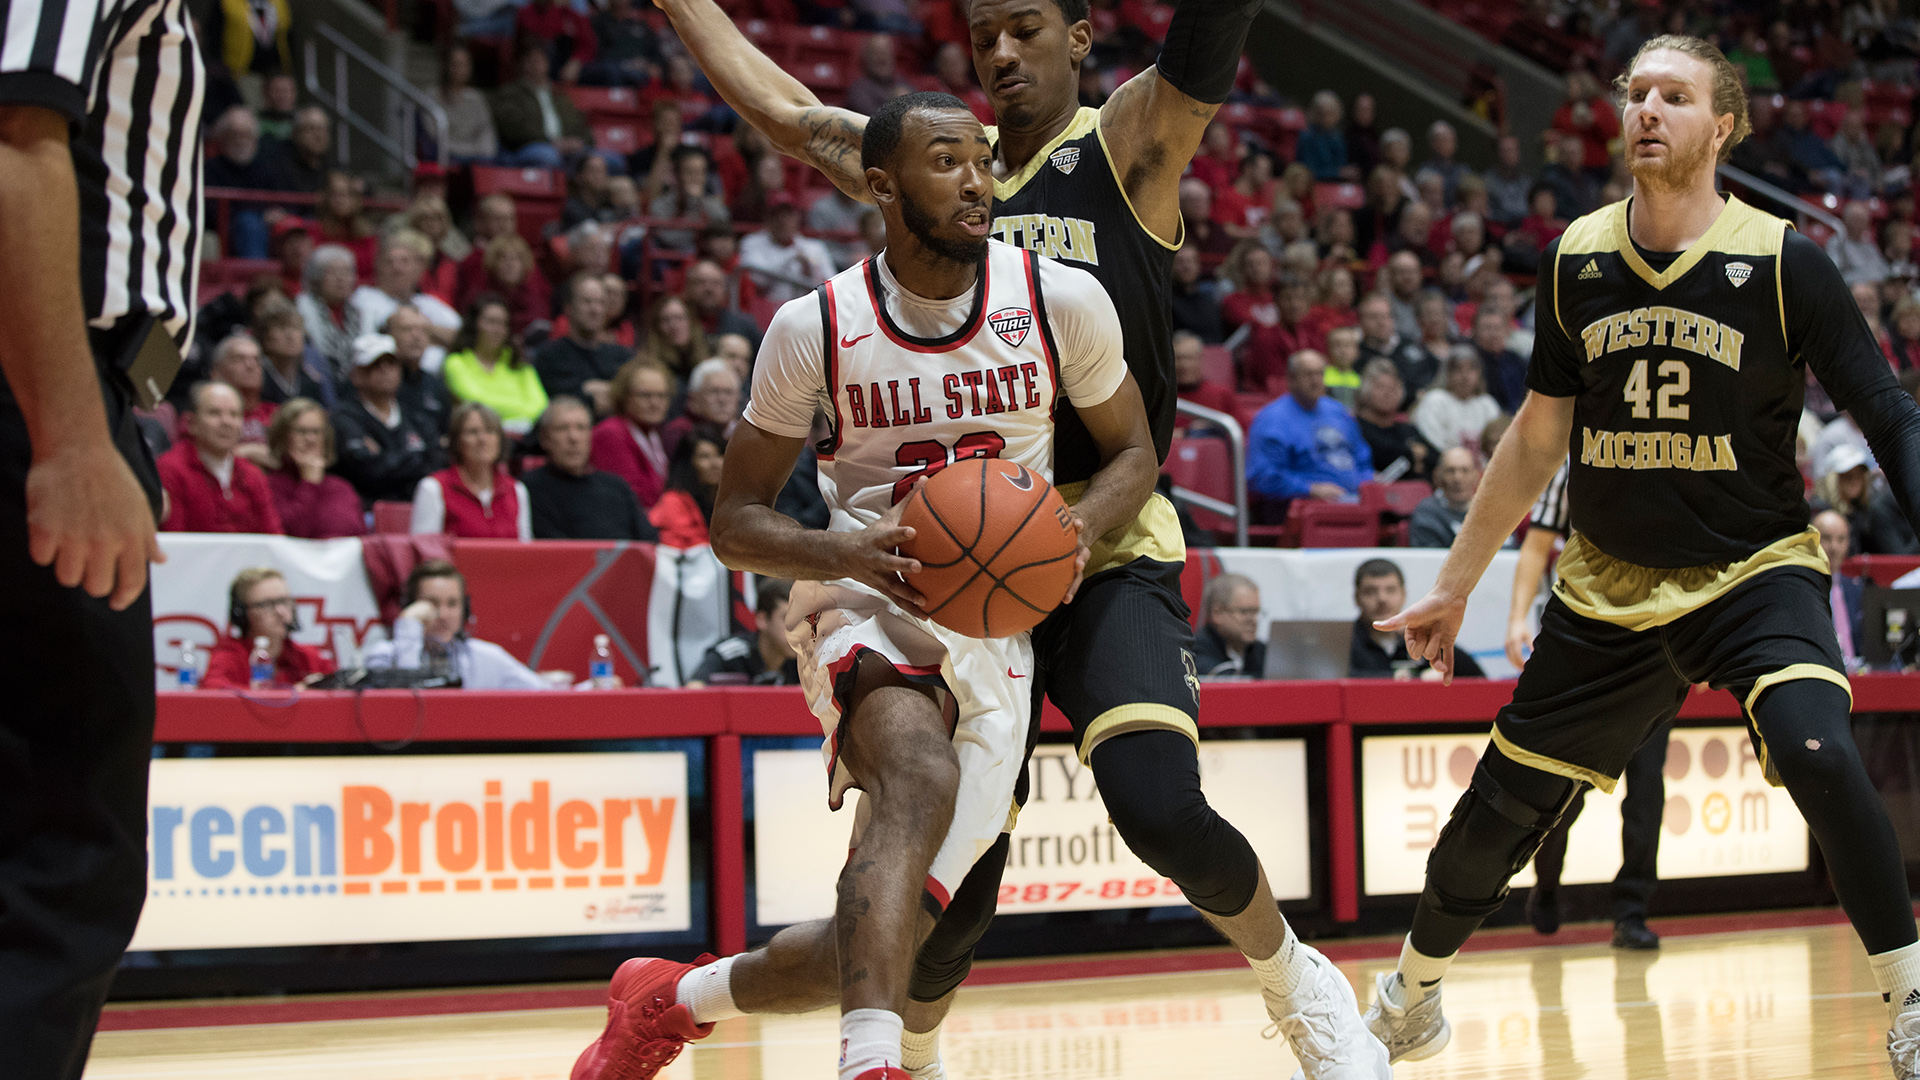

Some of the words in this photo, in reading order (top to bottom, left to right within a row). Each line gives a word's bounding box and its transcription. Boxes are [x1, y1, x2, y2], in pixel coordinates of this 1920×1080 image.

[1051, 153, 1080, 167] MAC
[990, 213, 1099, 266] TERN
[1578, 270, 1602, 280] adidas
[1725, 269, 1751, 278] MAC
[993, 316, 1030, 333] MAC
[1581, 305, 1744, 372] WESTERN
[846, 377, 932, 428] BALL
[943, 361, 1041, 419] STATE
[1623, 359, 1690, 420] 42
[1581, 426, 1738, 471] MICHIGAN
[1031, 756, 1102, 802] TY
